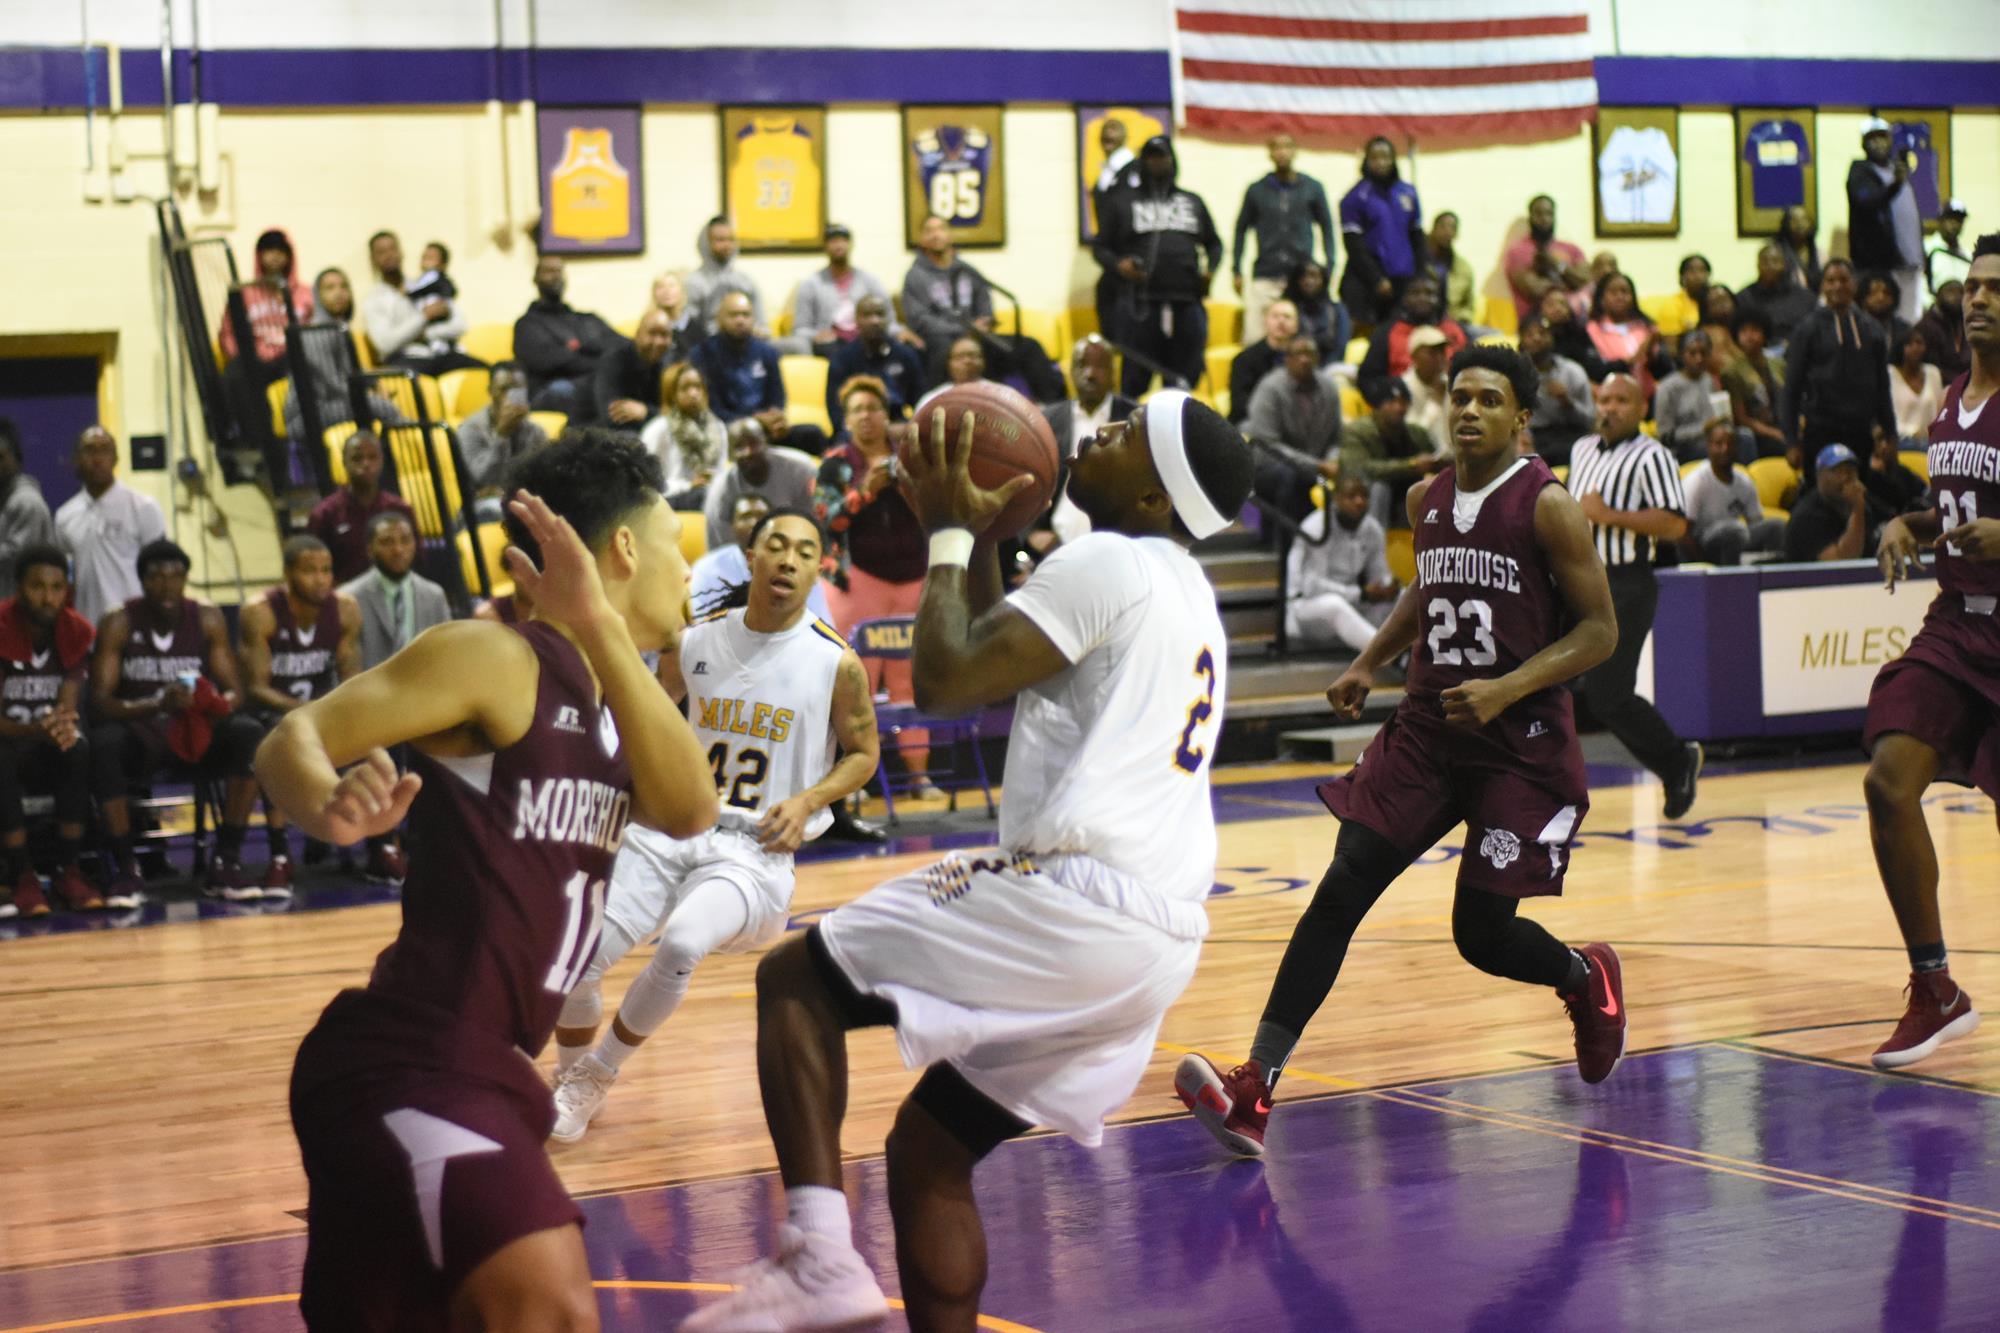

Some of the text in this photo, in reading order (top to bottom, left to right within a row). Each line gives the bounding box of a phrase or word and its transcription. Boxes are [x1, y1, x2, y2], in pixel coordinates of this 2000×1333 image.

[1927, 441, 2000, 483] OREHOUS
[1417, 547, 1520, 593] MOREHOUSE
[1428, 598, 1497, 666] 23
[1800, 626, 1905, 669] MILES
[699, 697, 794, 742] MILES
[1171, 643, 1215, 776] 2
